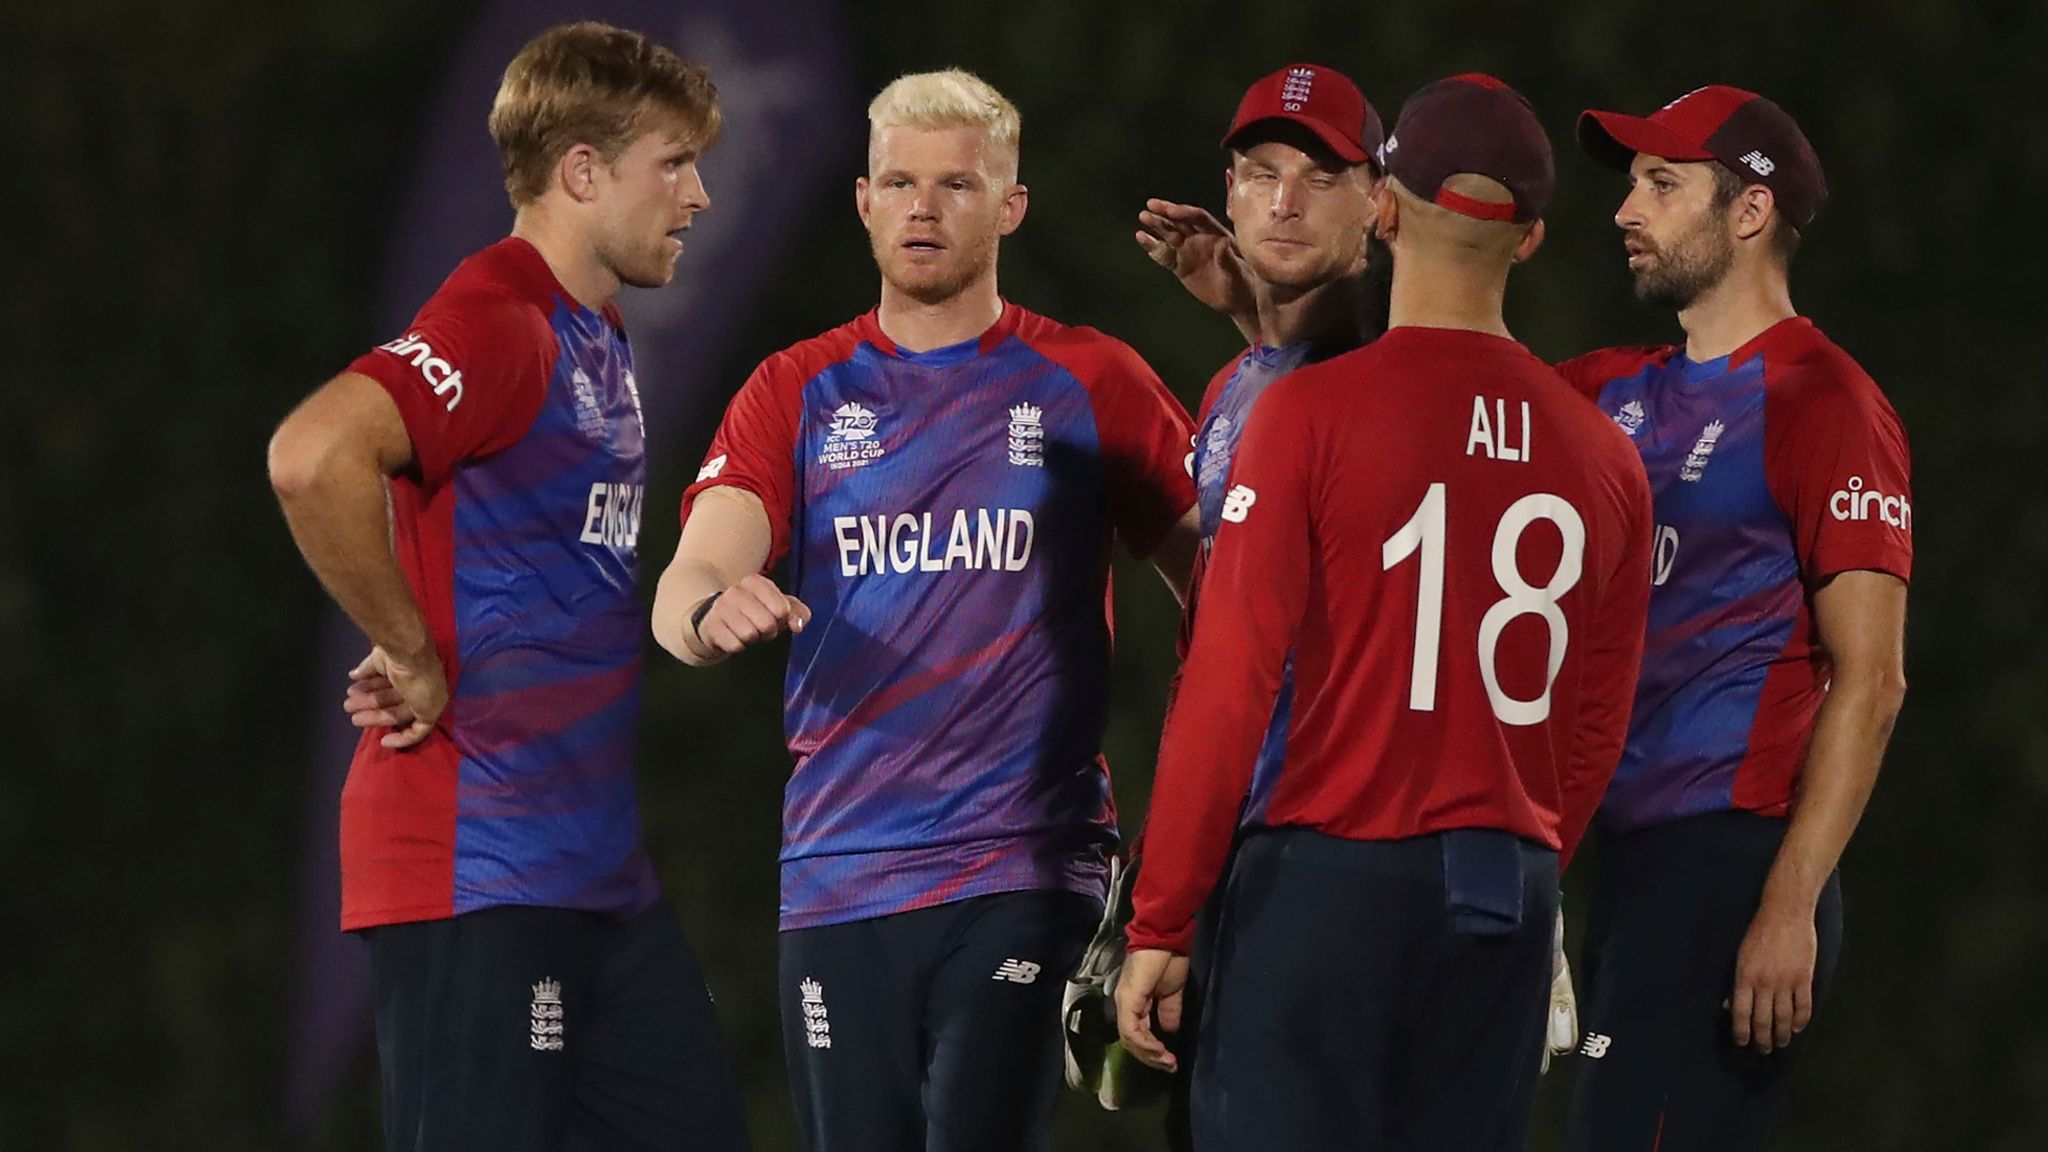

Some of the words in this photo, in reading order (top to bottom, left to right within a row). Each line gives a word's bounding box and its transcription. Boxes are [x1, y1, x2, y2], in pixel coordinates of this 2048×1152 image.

[379, 333, 464, 412] cinch
[818, 451, 860, 465] WORLD
[861, 448, 886, 459] CUP
[823, 441, 858, 454] MEN'S
[860, 440, 881, 450] T20
[1466, 395, 1531, 463] ALI
[1829, 475, 1912, 531] cinch
[833, 508, 1035, 578] ENGLAND
[1382, 482, 1586, 726] 18
